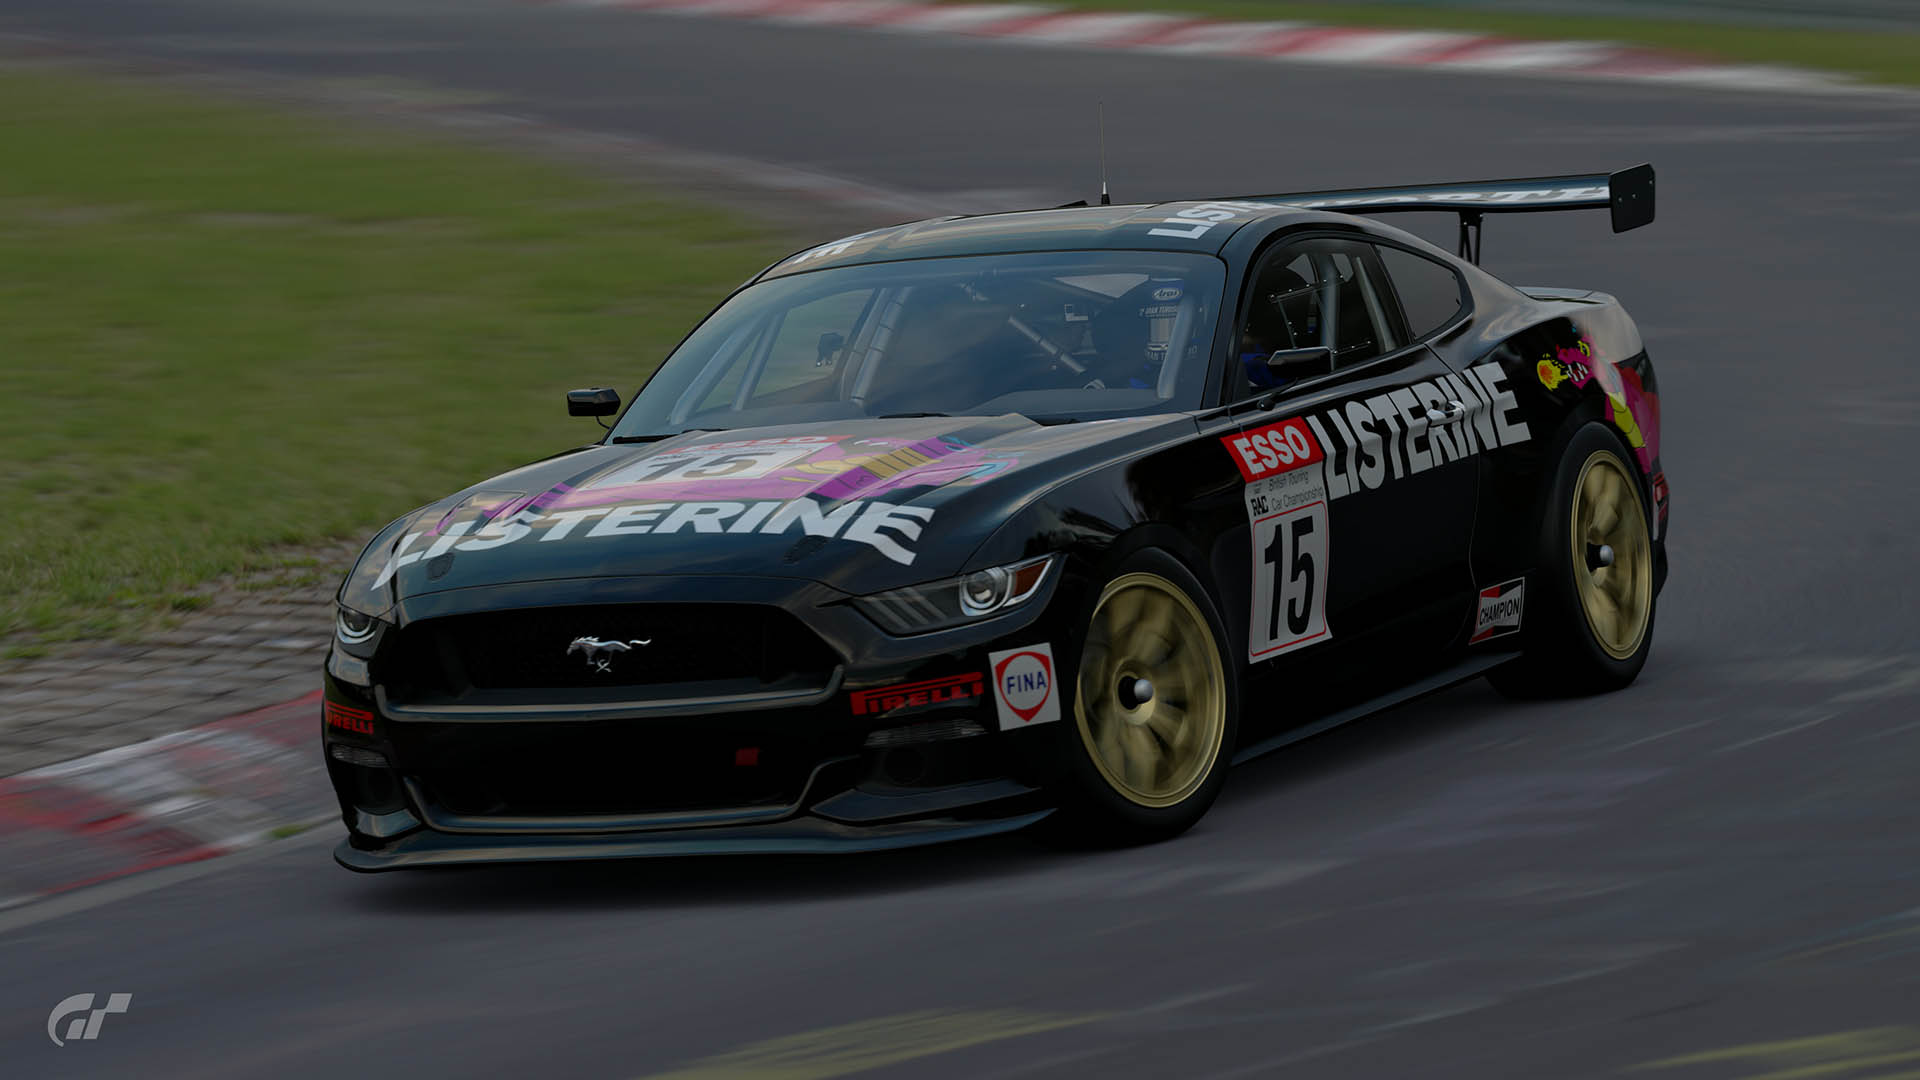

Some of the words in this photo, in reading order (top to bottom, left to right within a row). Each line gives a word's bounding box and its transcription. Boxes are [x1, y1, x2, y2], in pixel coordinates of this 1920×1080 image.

[1232, 425, 1310, 475] ESSO
[1306, 361, 1532, 500] LISTERINE
[1271, 498, 1283, 511] Car
[370, 501, 936, 591] LISTERINE
[1264, 515, 1315, 641] 15
[1480, 597, 1520, 625] CHAMPION
[849, 671, 984, 716] PIRELLI
[1007, 671, 1046, 694] FINA
